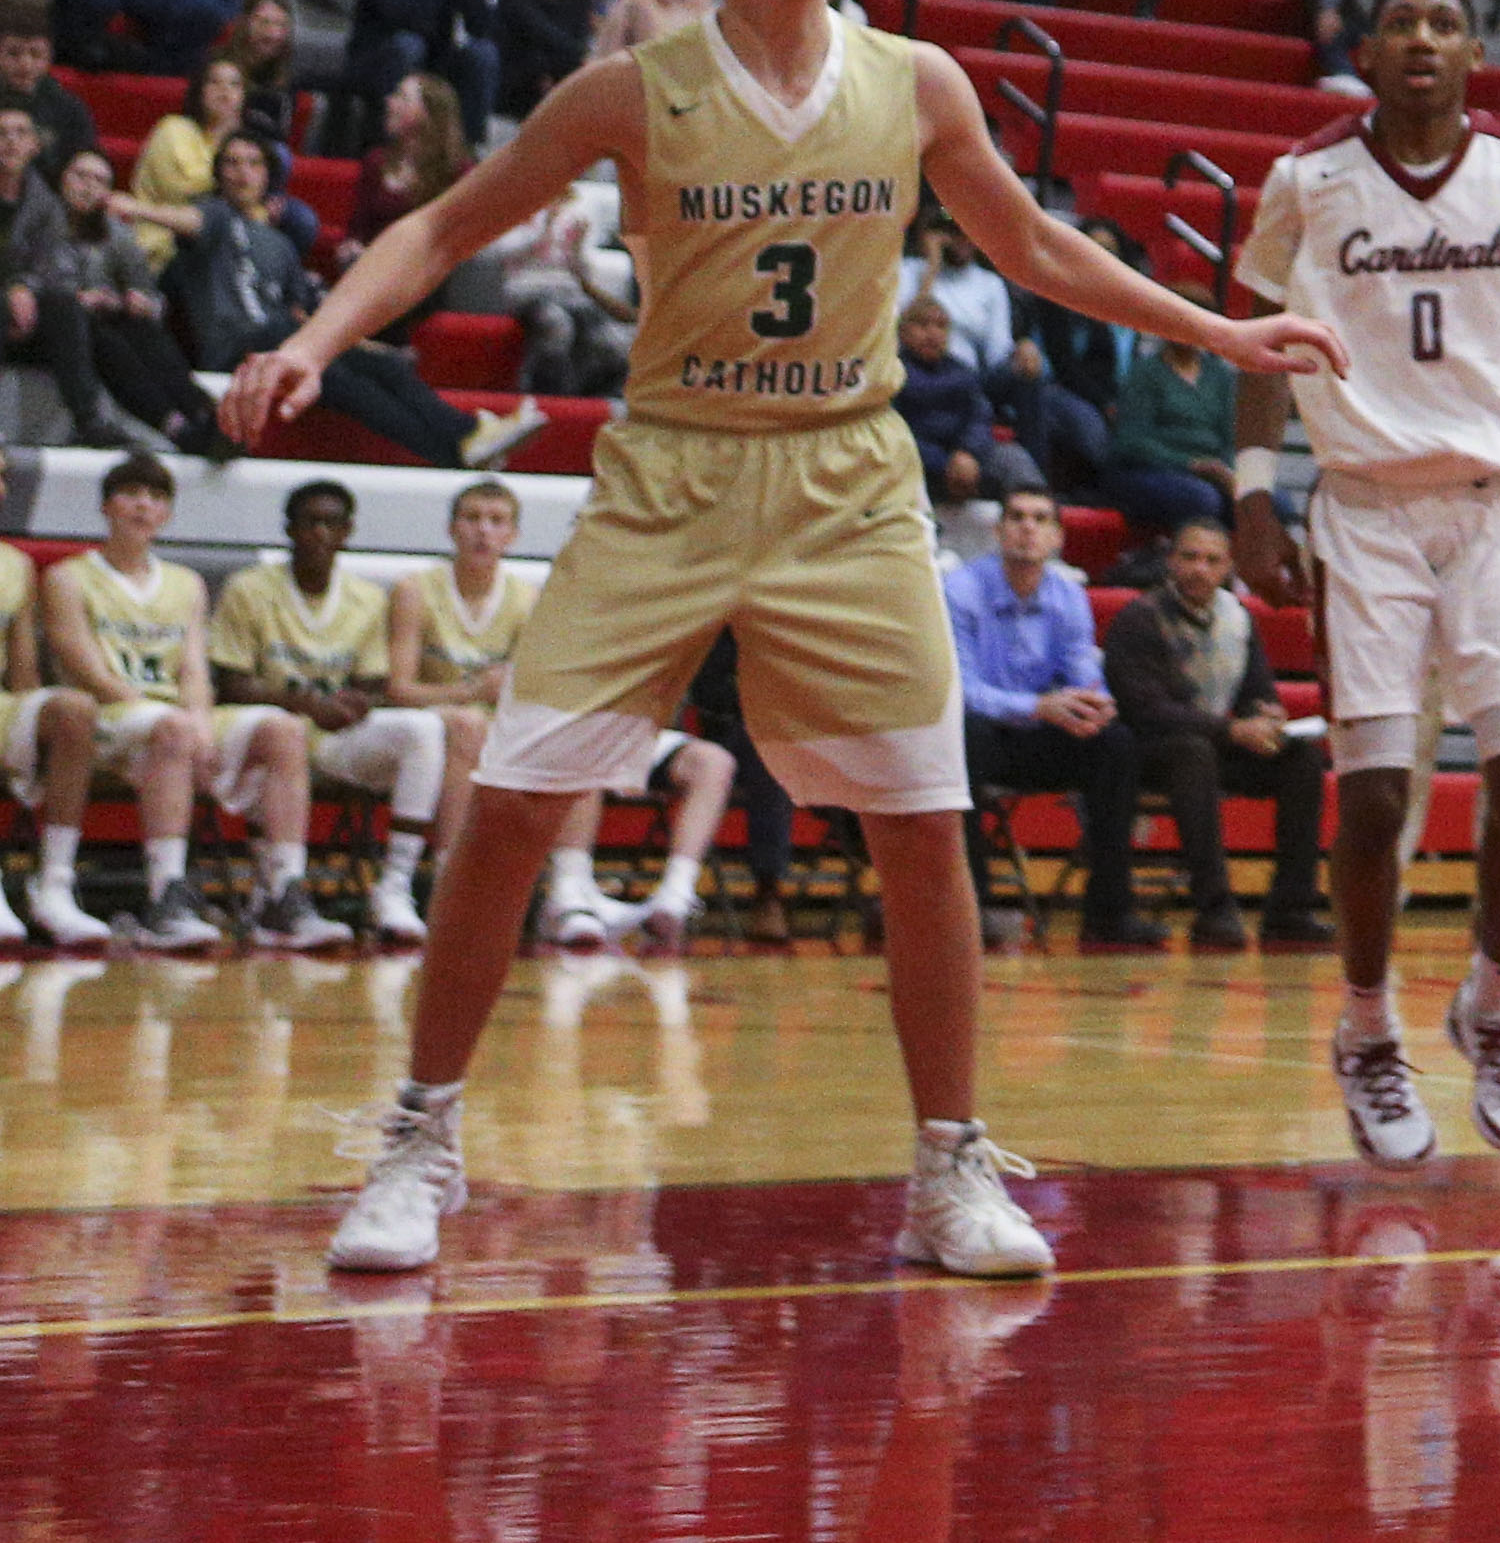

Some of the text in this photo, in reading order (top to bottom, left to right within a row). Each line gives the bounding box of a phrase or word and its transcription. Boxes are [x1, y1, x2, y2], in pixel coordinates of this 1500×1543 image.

[680, 178, 893, 221] MUSKEGON
[750, 242, 817, 339] 3
[1412, 289, 1445, 361] 0
[681, 355, 864, 396] CATHOLIC
